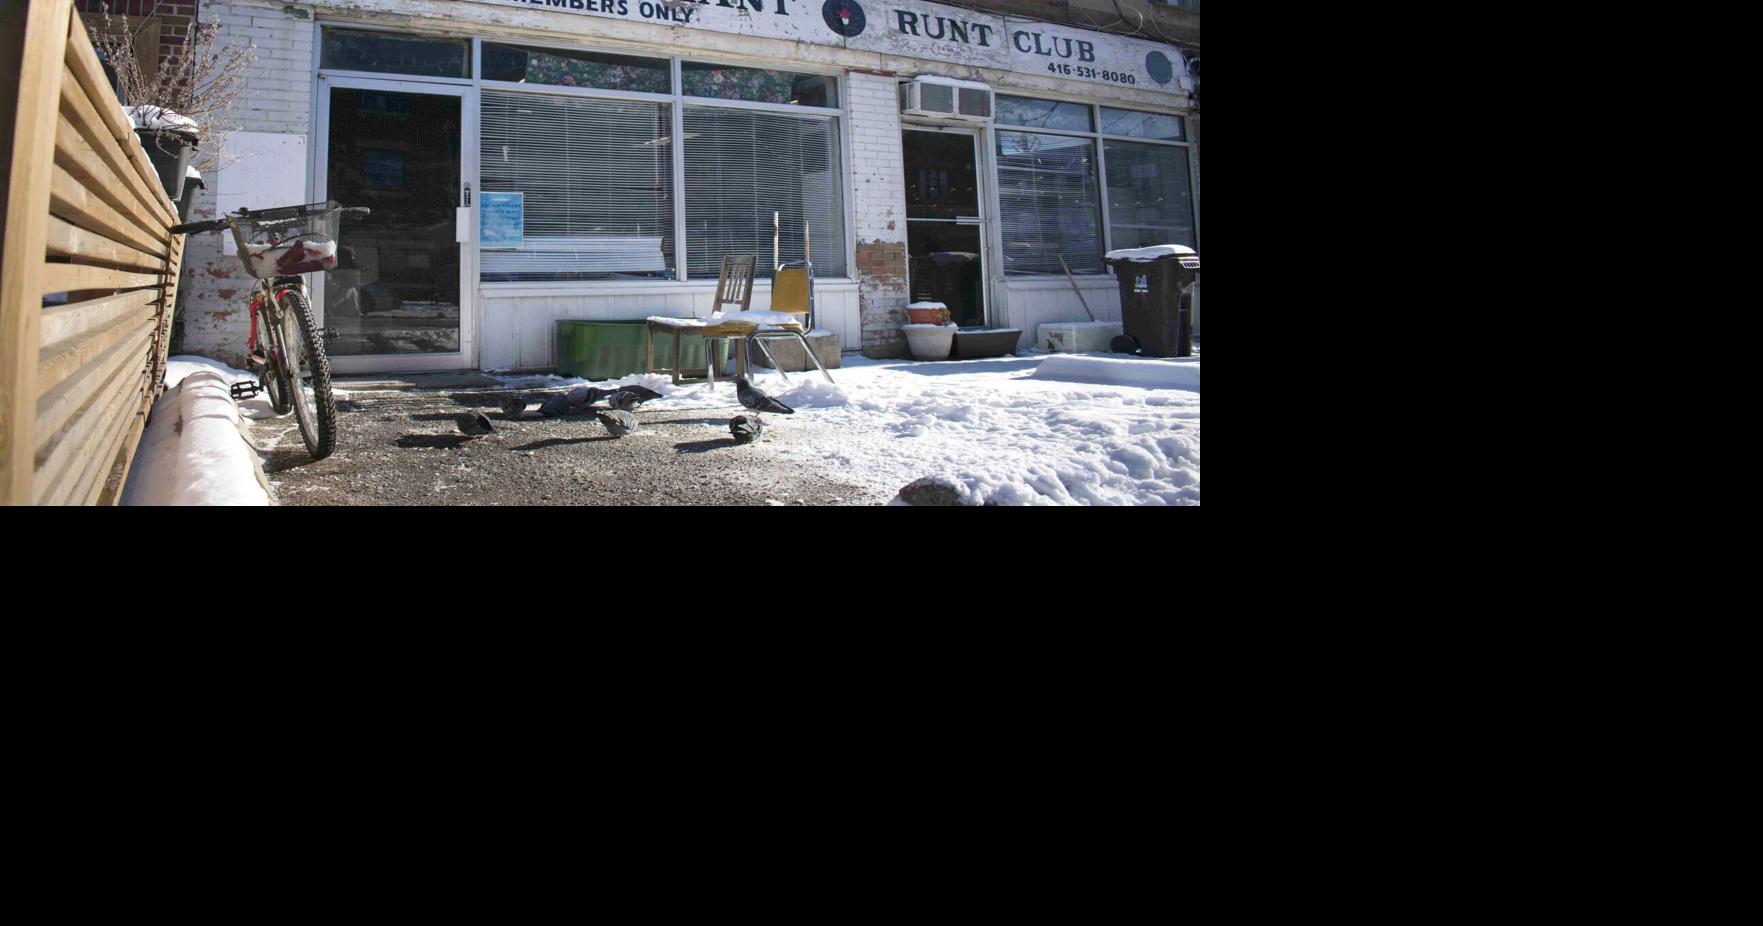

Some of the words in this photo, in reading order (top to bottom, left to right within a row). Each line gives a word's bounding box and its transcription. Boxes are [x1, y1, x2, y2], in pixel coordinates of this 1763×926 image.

[639, 3, 694, 23] ONLY
[895, 9, 992, 47] RUNT
[1013, 30, 1096, 62] CLUB
